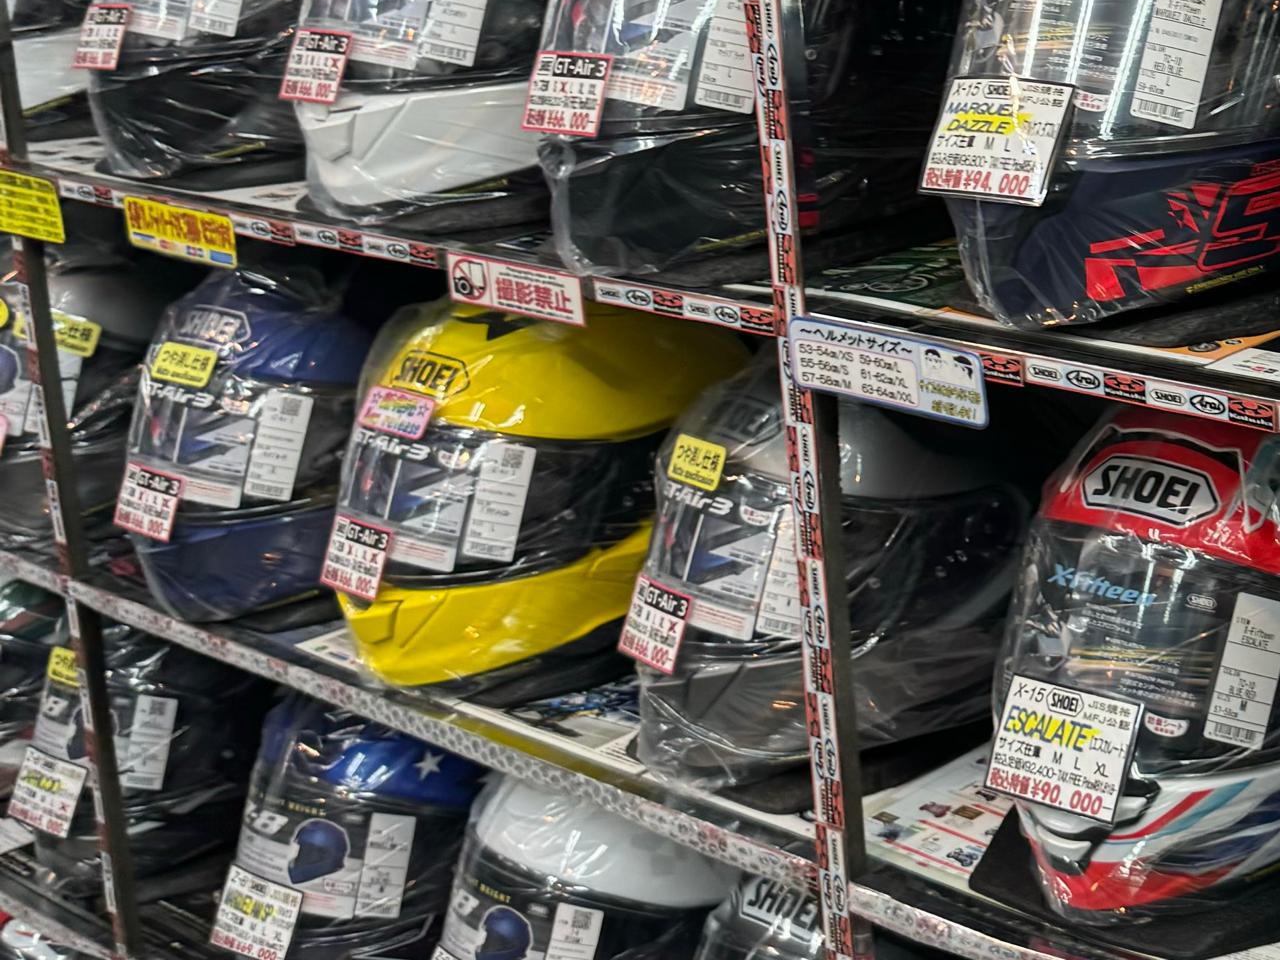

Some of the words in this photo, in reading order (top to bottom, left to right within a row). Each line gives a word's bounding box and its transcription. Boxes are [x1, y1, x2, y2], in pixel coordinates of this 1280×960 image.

[946, 119, 1012, 135] DAZZLE
[495, 276, 574, 315] 撮影禁止
[1031, 365, 1060, 379] SHOEI
[1071, 370, 1097, 390] Arai
[1152, 390, 1184, 406] SHOEI
[1194, 394, 1223, 415] Arai
[1092, 463, 1202, 515] SHOEI
[1013, 683, 1047, 704] X-15
[1050, 692, 1079, 713] SHOEI
[1003, 705, 1093, 752] ESCALATE
[1051, 751, 1063, 766] M
[1073, 757, 1081, 771] L
[1093, 762, 1110, 778] XL
